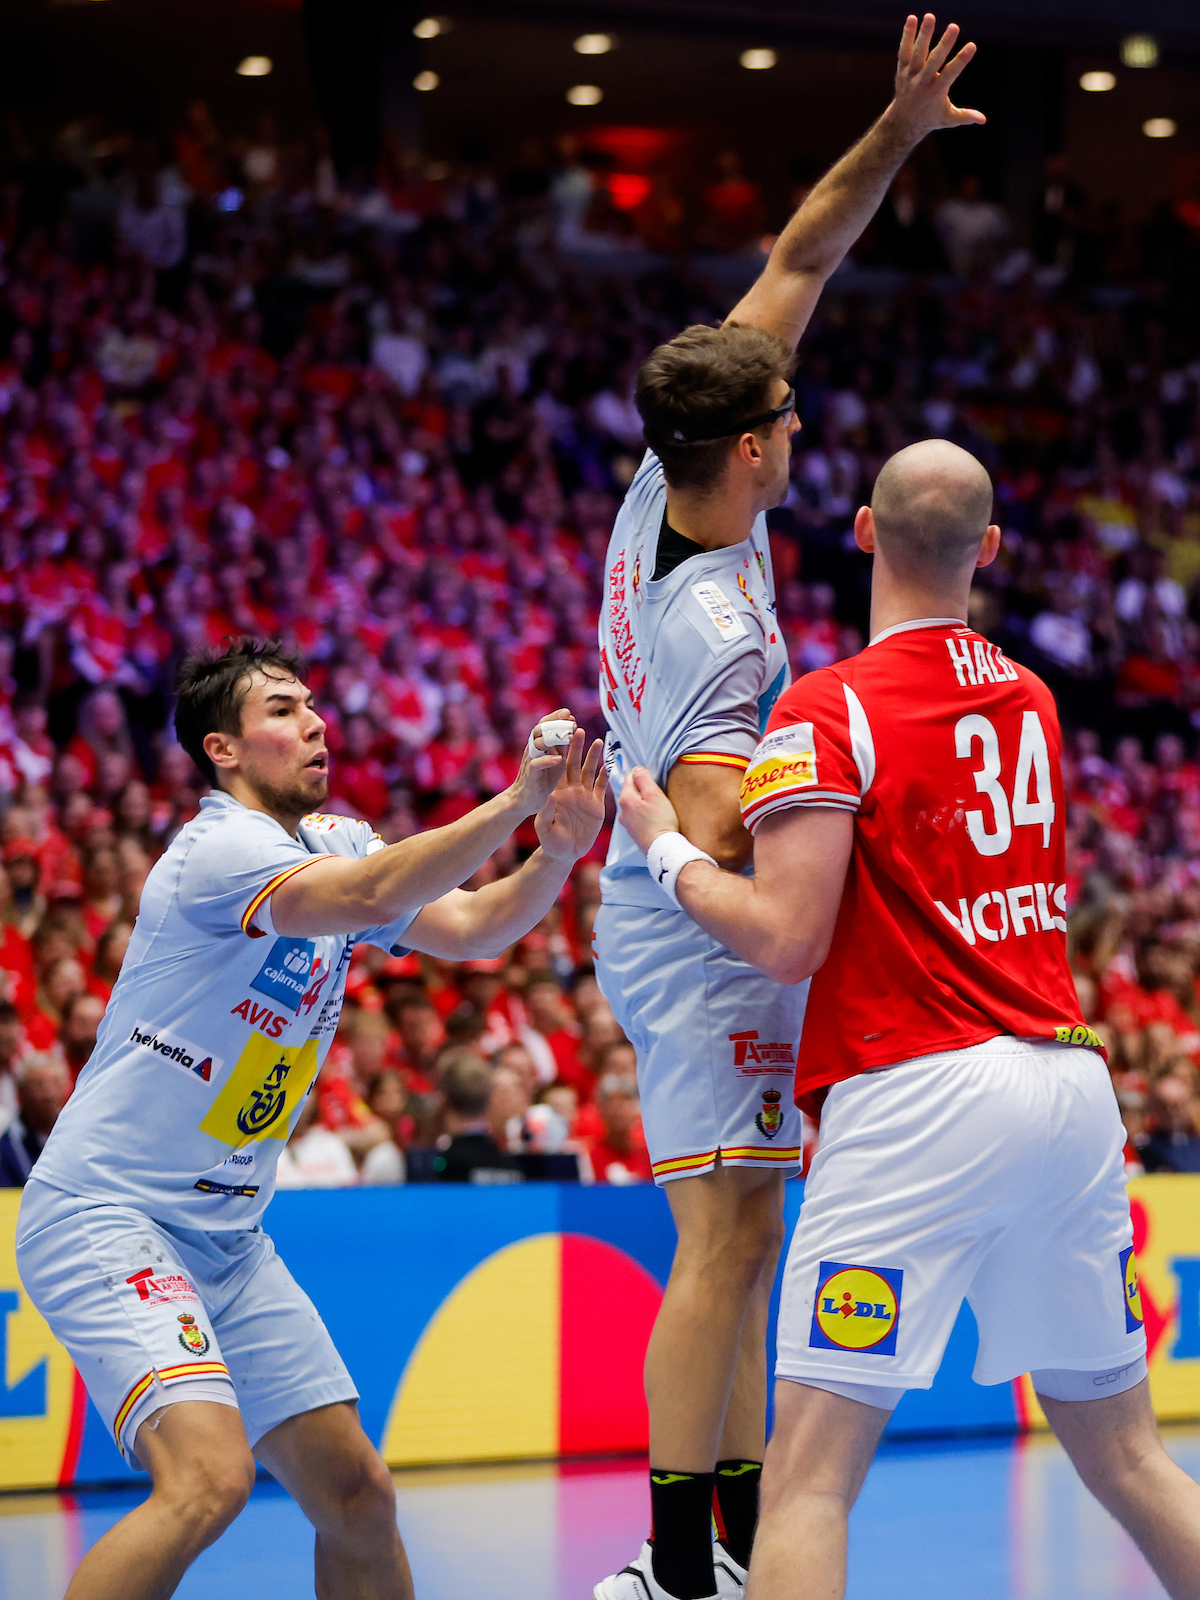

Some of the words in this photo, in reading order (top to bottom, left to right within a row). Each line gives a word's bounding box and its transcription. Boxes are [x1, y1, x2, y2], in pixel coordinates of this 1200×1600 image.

[945, 638, 1019, 687] HALD
[740, 761, 808, 799] Josera
[954, 711, 1056, 857] 34
[230, 998, 288, 1038] AVIS
[130, 1027, 194, 1068] helvetia
[822, 1292, 891, 1320] LIDL
